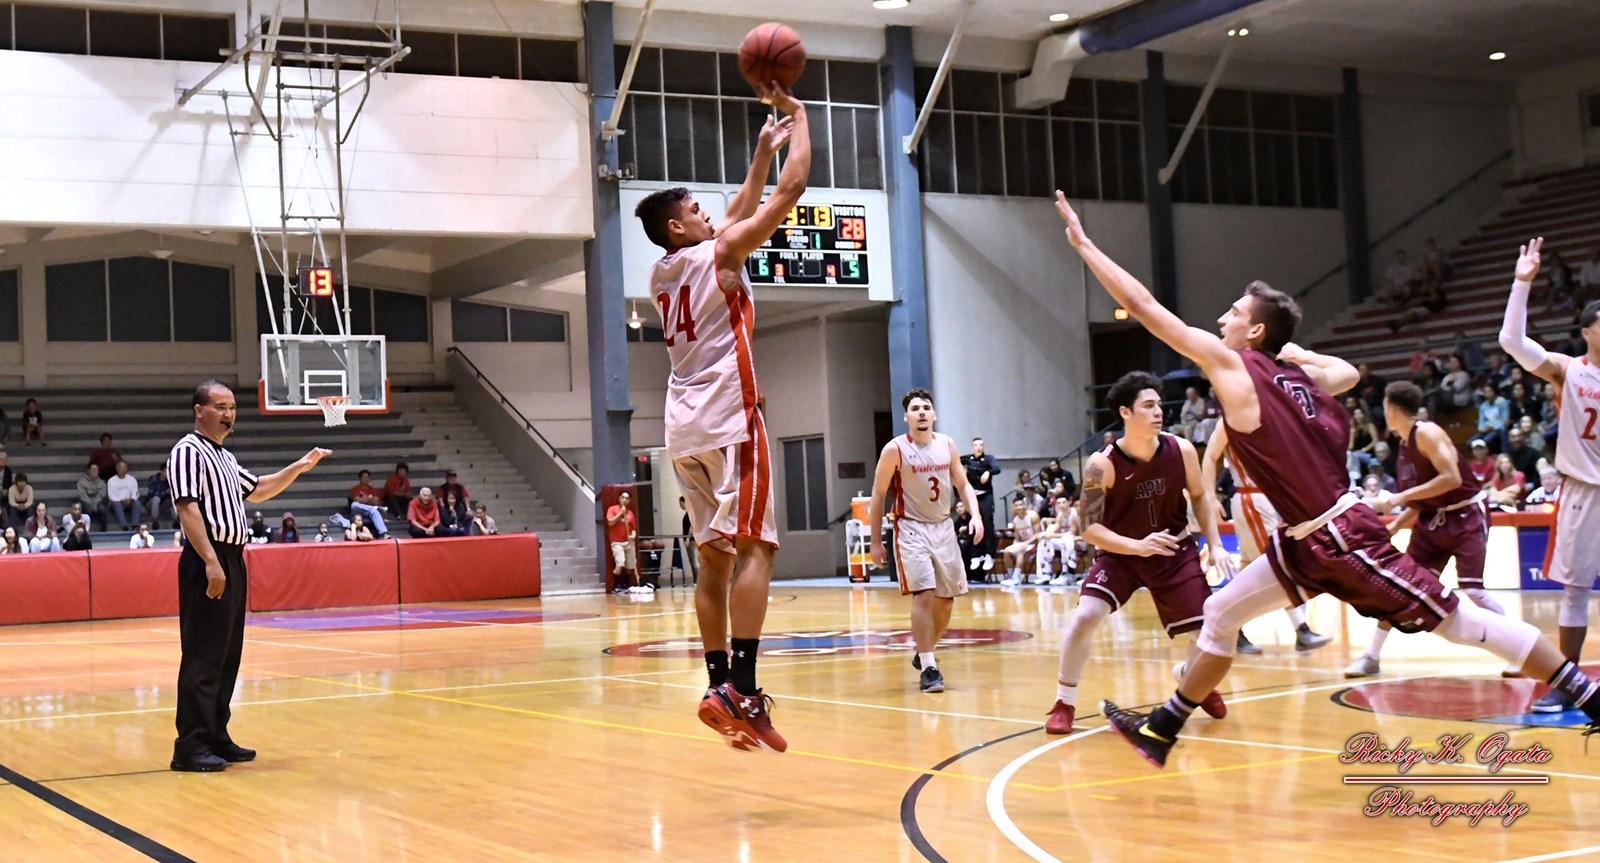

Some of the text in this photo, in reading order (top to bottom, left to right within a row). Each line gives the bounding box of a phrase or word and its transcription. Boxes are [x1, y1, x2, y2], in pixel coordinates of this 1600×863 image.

[834, 206, 865, 217] VISITOR
[842, 218, 865, 239] 28
[815, 232, 821, 249] 1
[758, 259, 769, 276] 6
[849, 261, 860, 278] 5
[309, 269, 332, 295] 13
[657, 284, 697, 347] 24
[928, 476, 940, 502] 3
[1135, 478, 1166, 499] APU
[1148, 500, 1158, 527] 1
